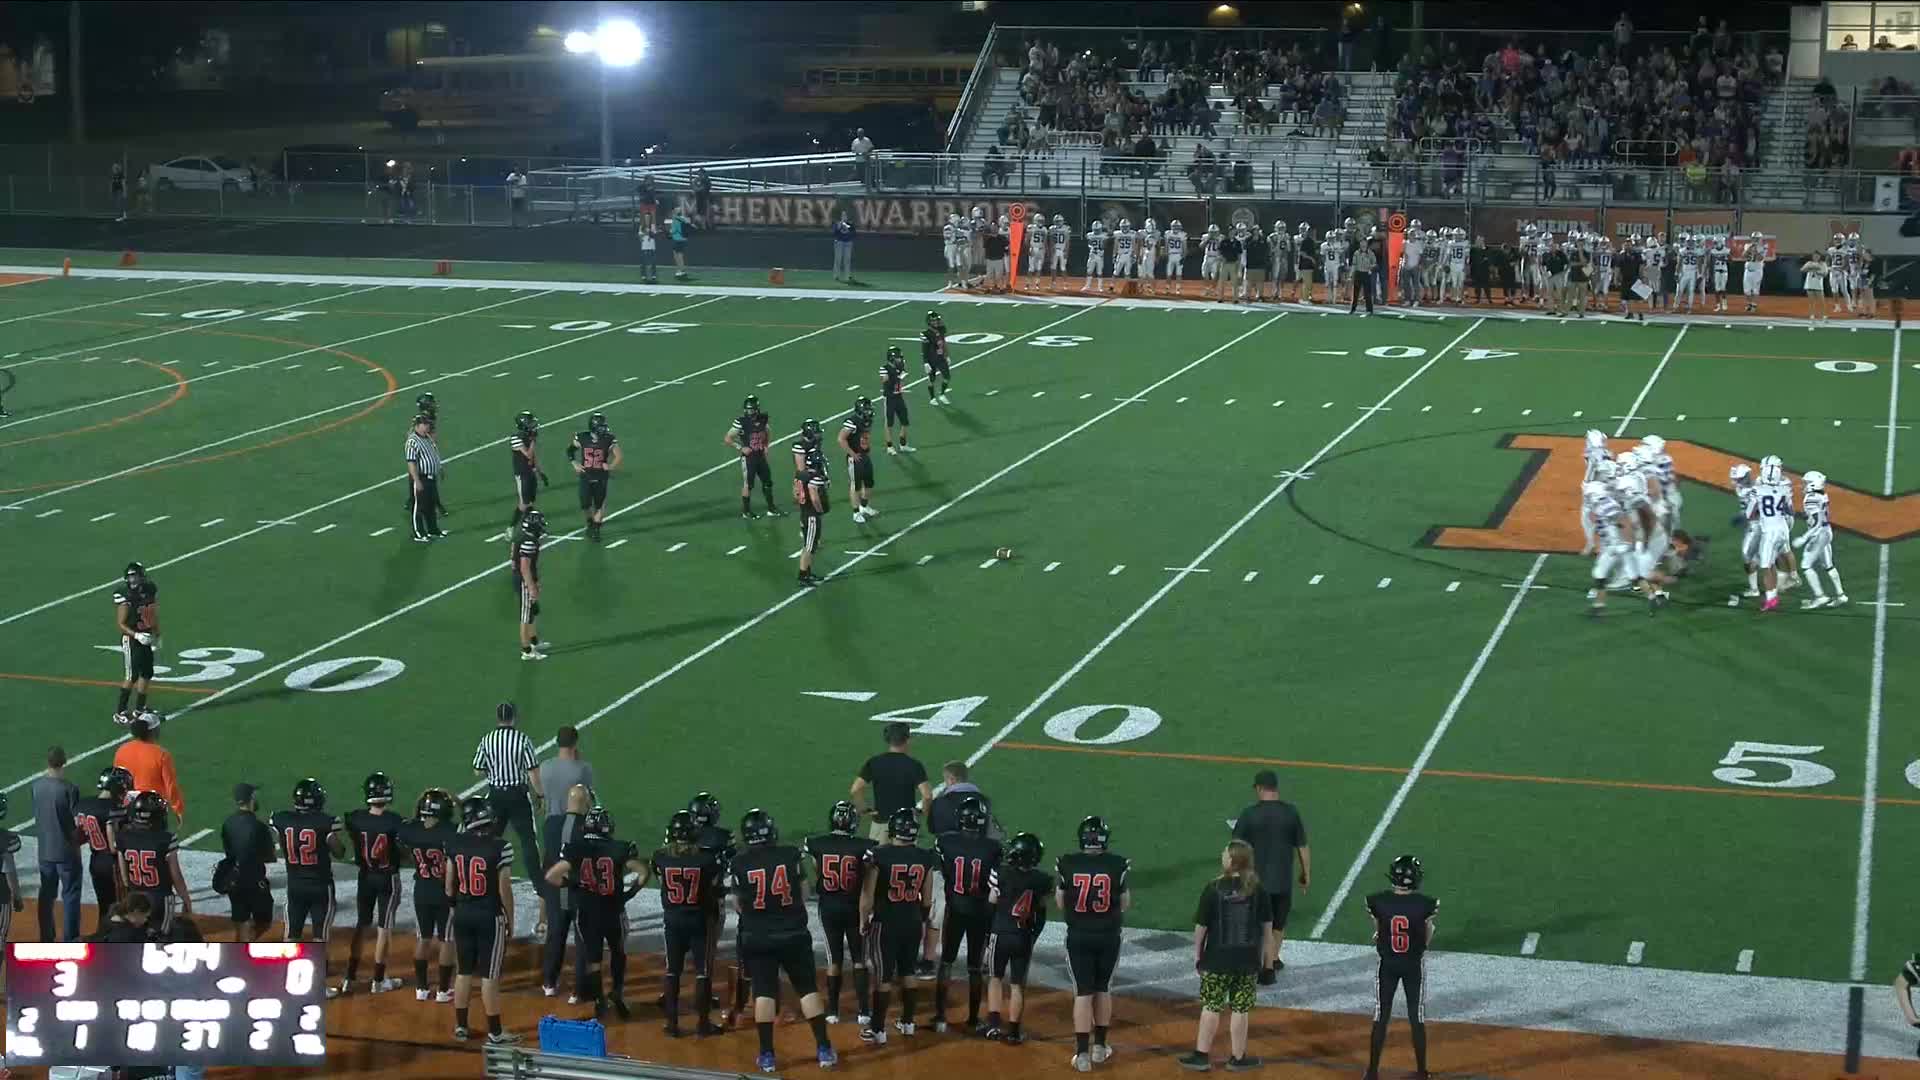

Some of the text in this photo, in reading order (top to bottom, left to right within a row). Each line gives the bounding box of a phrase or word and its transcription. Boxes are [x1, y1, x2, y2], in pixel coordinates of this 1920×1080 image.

[1762, 495, 1787, 518] 84
[284, 827, 318, 865] 12
[361, 831, 390, 869] 14
[125, 850, 160, 887] 35
[455, 854, 487, 896] 16
[580, 857, 615, 896] 43
[664, 867, 701, 905] 57
[747, 865, 793, 910] 74
[887, 864, 925, 902] 53
[954, 856, 982, 895] 11
[1073, 873, 1112, 913] 73
[1391, 915, 1409, 953] 6
